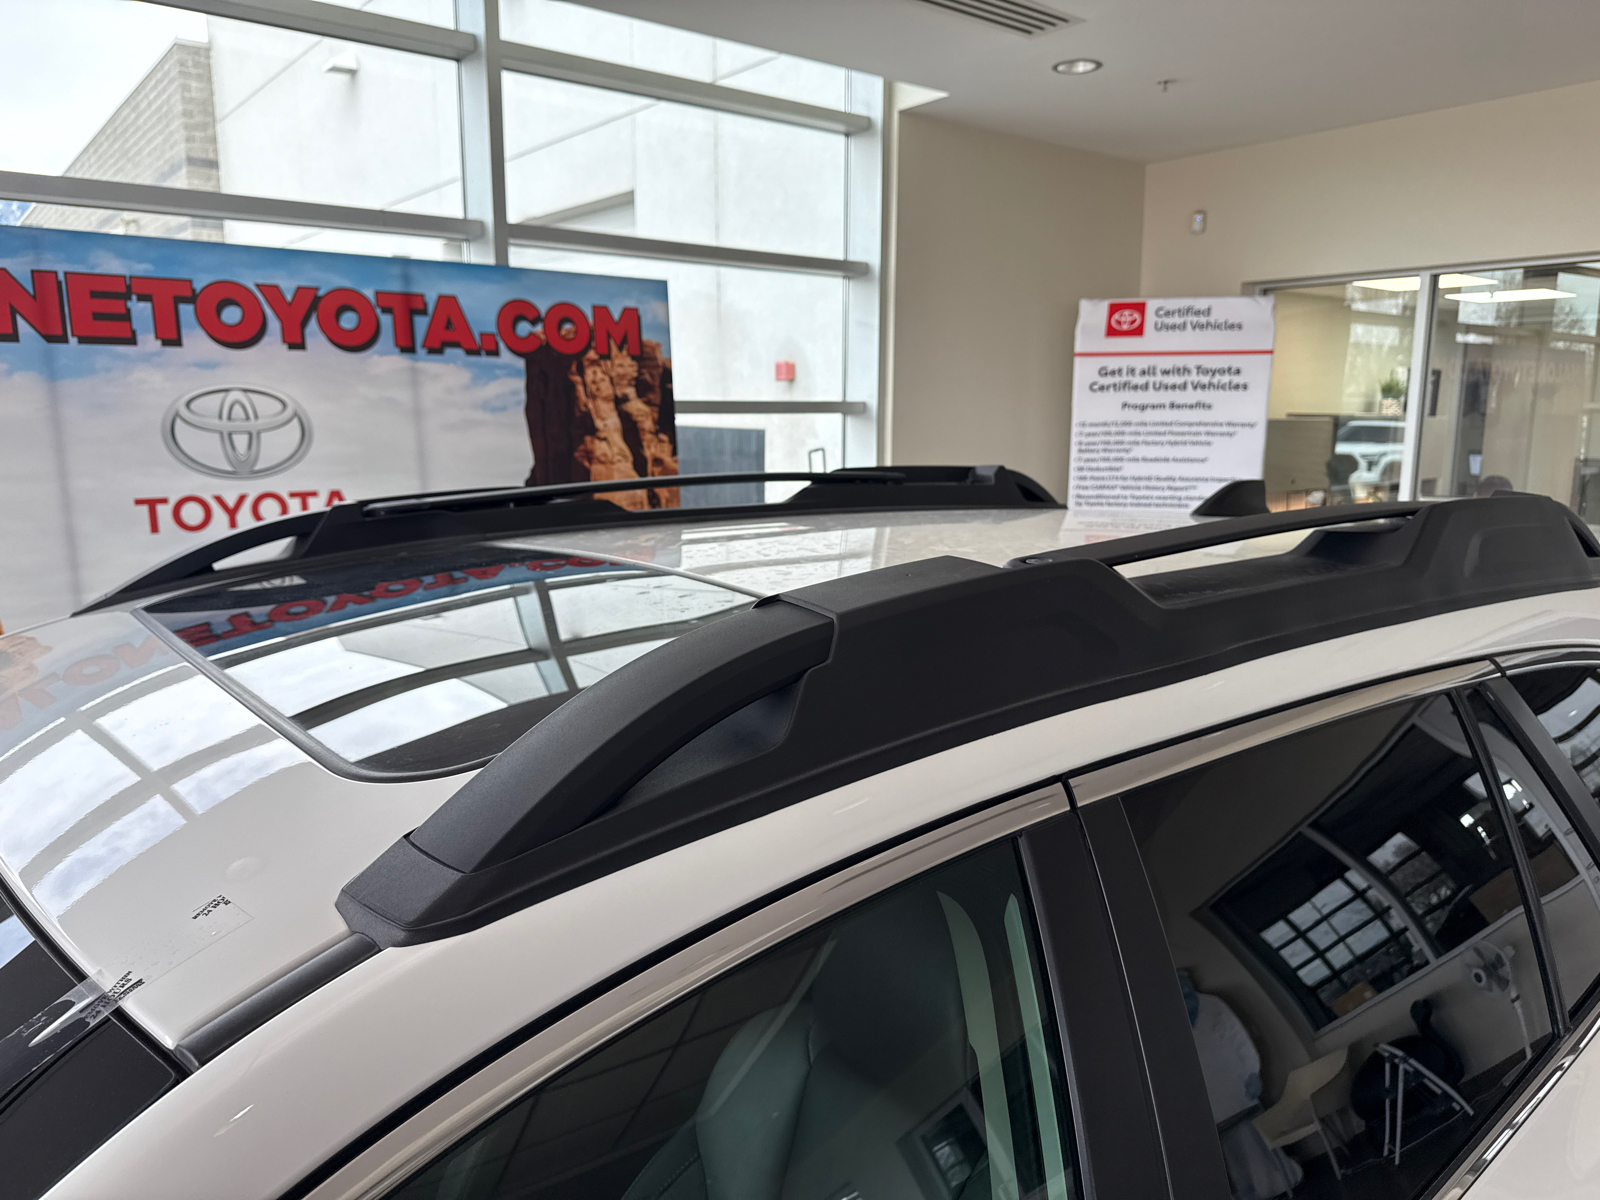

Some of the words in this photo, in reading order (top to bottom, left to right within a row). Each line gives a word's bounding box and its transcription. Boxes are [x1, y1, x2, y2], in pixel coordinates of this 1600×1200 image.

[0, 267, 642, 357] NETOYOTA.COM
[1154, 305, 1212, 318] Certified
[1154, 320, 1187, 332] Used
[1189, 319, 1244, 332] Vehicles
[1097, 366, 1122, 378] Get
[1125, 365, 1136, 377] it
[1138, 364, 1157, 377] all
[1159, 364, 1191, 377] with
[1194, 364, 1242, 380] Toyota
[1088, 380, 1149, 393] Certified
[1152, 380, 1187, 392] Used
[1190, 379, 1249, 392] Vehicles
[1121, 401, 1166, 412] Program
[1168, 400, 1213, 410] Benefits
